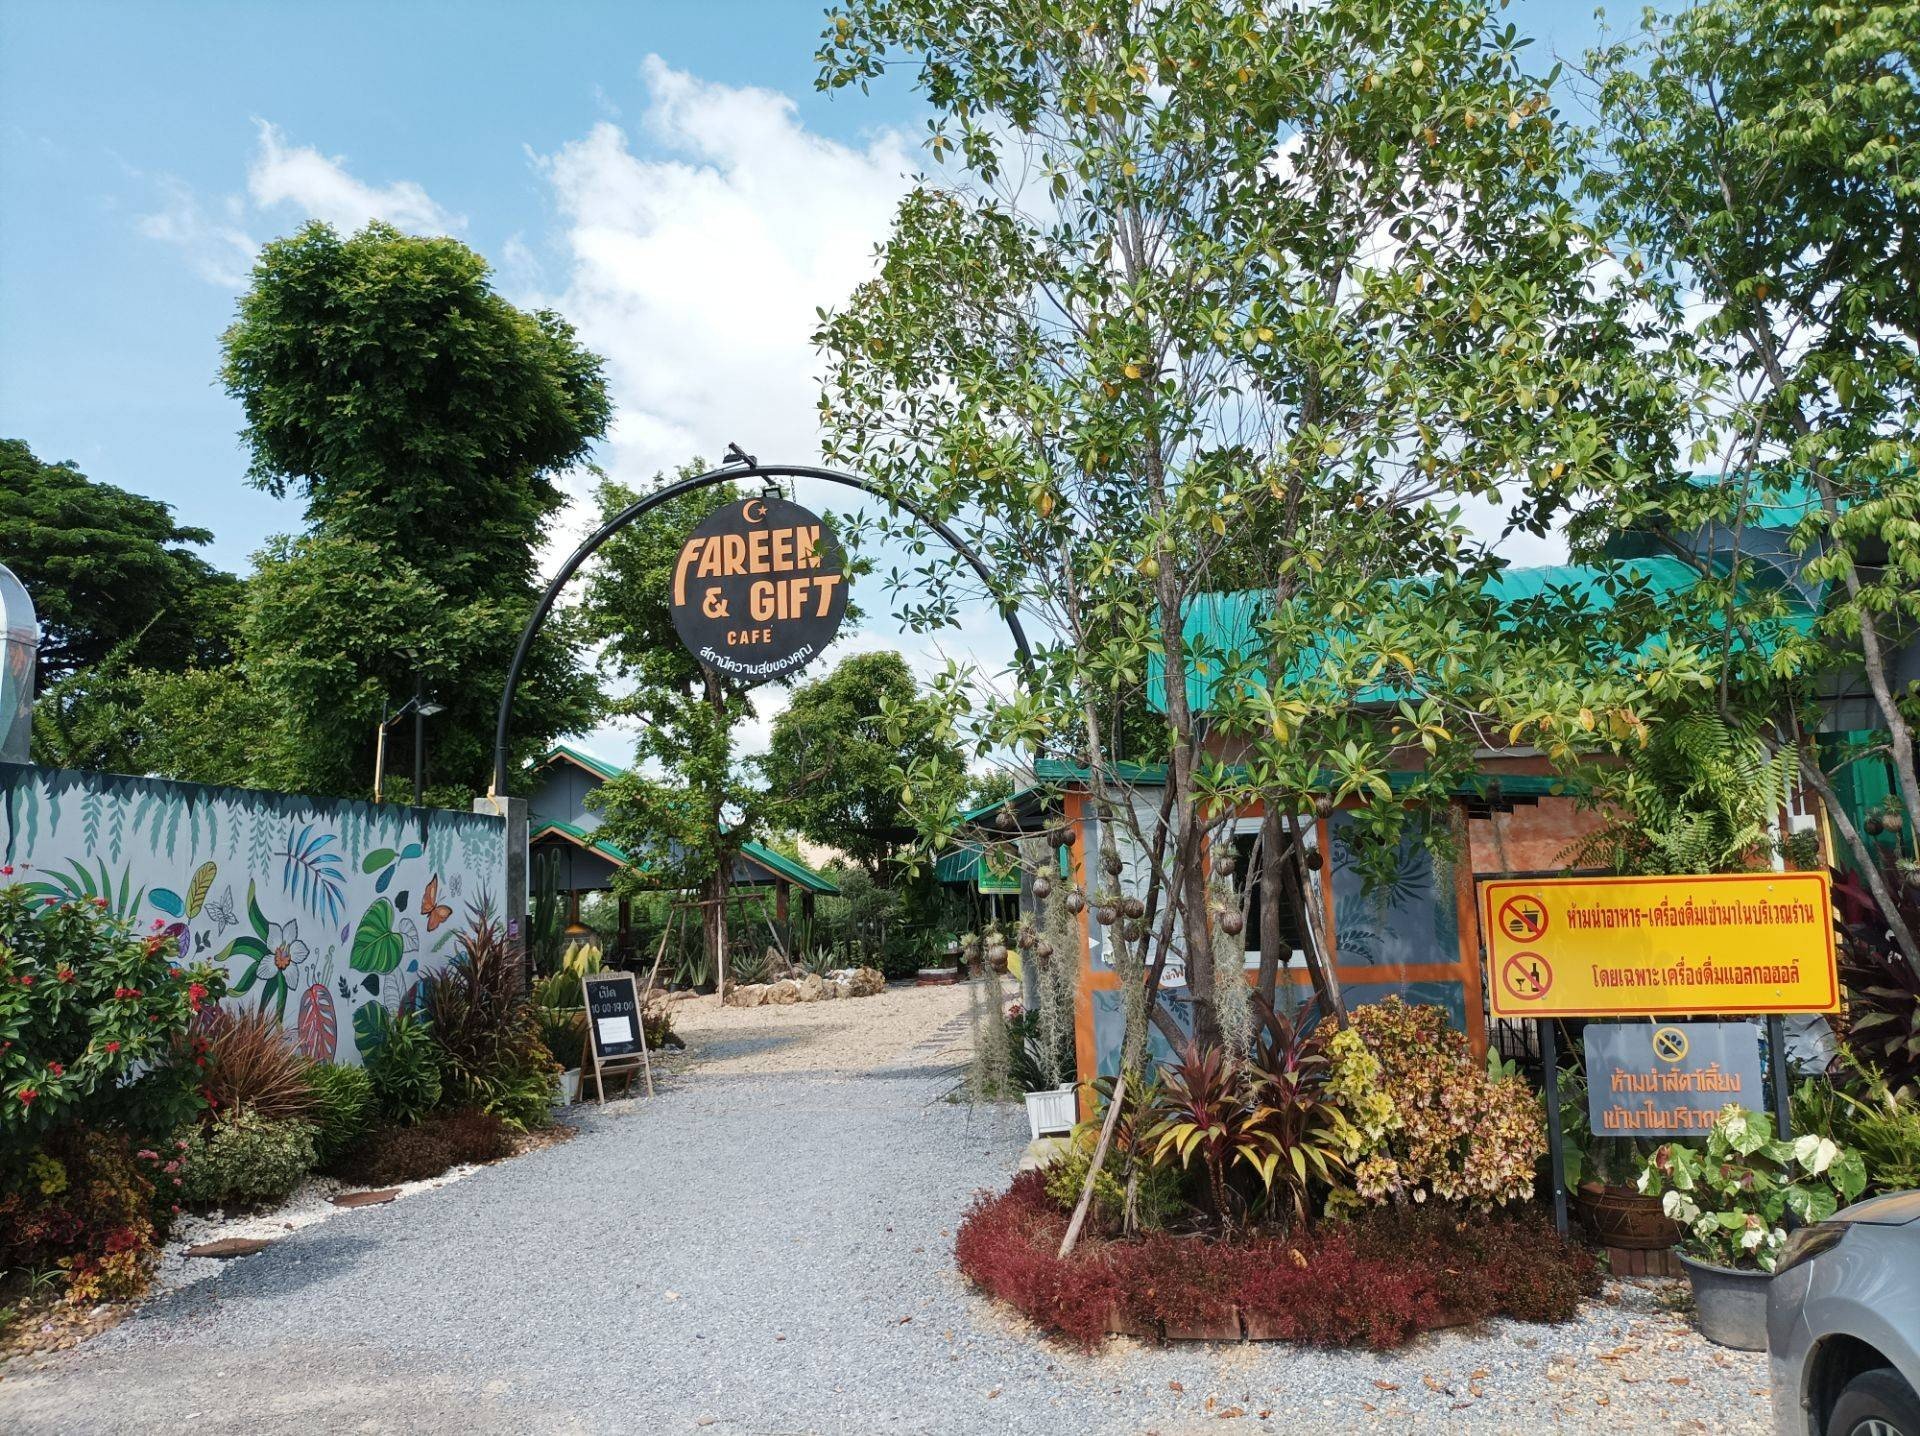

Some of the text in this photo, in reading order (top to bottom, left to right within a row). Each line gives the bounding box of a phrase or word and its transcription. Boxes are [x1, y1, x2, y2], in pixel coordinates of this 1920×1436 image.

[674, 525, 821, 606] FAREEN
[702, 574, 841, 622] & GIFT
[1611, 1062, 1742, 1092] ห้ามนำสัตว์เลี้ยง
